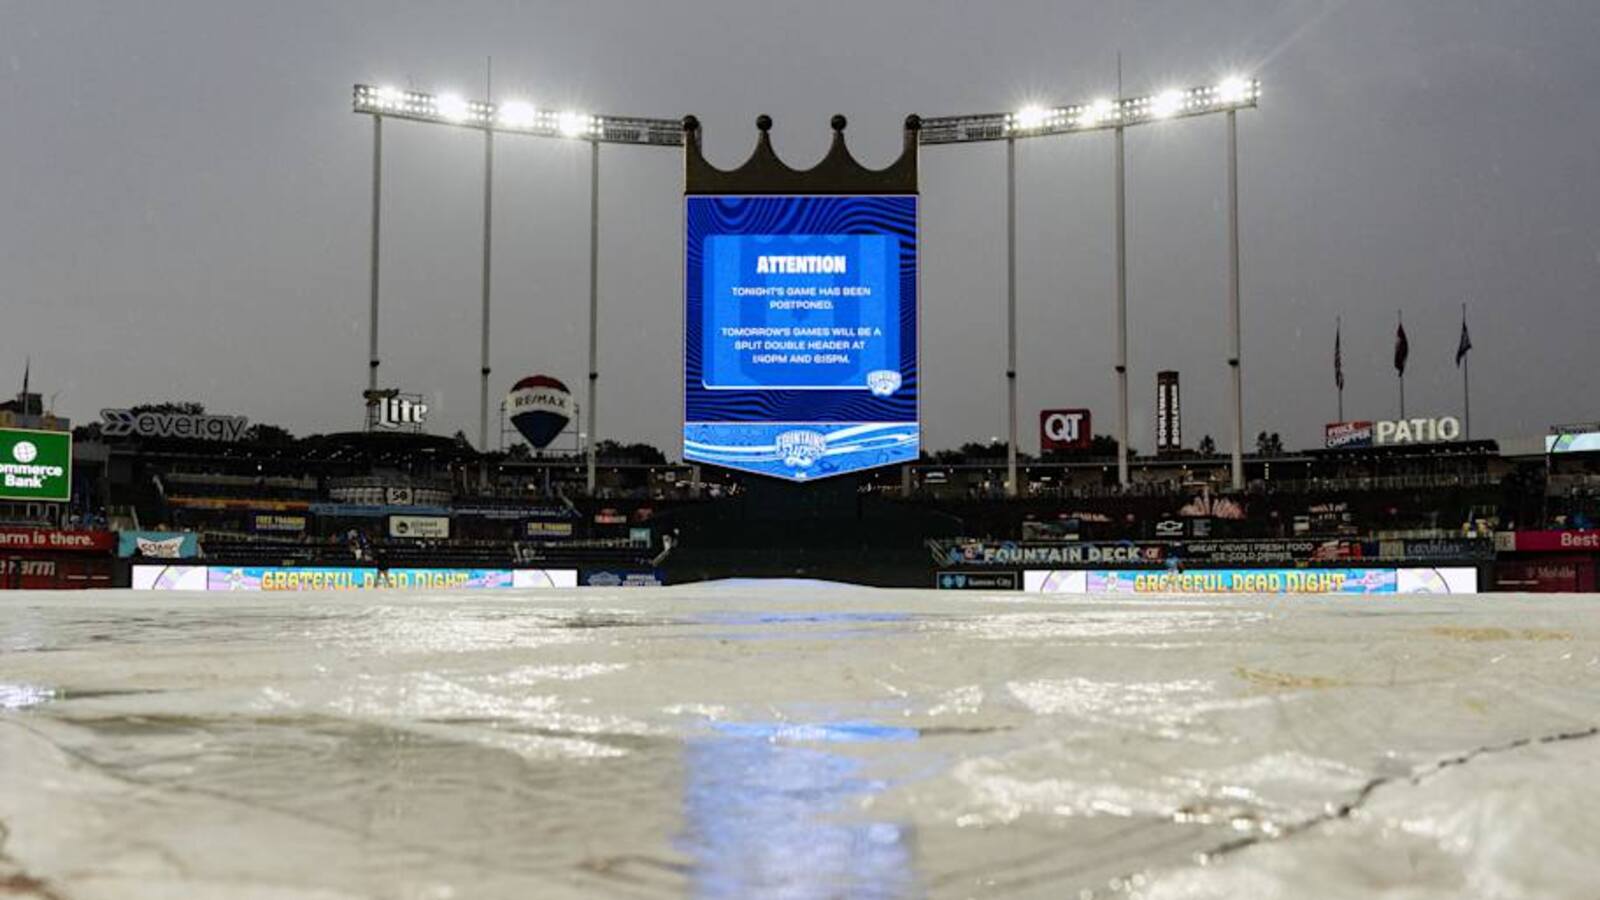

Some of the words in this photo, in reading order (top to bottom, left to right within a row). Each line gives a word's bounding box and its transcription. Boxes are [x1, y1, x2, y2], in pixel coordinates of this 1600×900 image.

[757, 256, 846, 273] ATTENTION
[732, 287, 784, 296] TONIGHT'S
[786, 287, 816, 296] GAME
[819, 287, 840, 296] HAS
[843, 287, 871, 296] BEEN
[769, 300, 834, 309] POSTPONED.
[722, 327, 790, 336] TOMORROW'S
[793, 327, 830, 336] GAMES
[832, 327, 855, 336] WILL
[858, 327, 871, 336] BE
[873, 327, 881, 336] A
[735, 341, 761, 350] SPLIT
[764, 341, 806, 350] DOUBLE
[808, 341, 850, 350] HEADER
[852, 341, 865, 350] AT
[789, 354, 812, 363] AND
[514, 393, 565, 408] RE/MAX
[377, 397, 428, 429] Lite
[137, 412, 247, 441] evergy
[1045, 413, 1083, 442] QT
[1377, 416, 1460, 442] PATIO
[5, 475, 42, 488] Bank
[33, 531, 46, 544] is
[50, 532, 95, 546] there.
[1561, 532, 1598, 546] Best
[984, 547, 1082, 562] FOUNTAIN
[1089, 547, 1140, 561] DECK
[1288, 543, 1314, 552] FOOD
[262, 571, 358, 589] GRATEFUL
[364, 572, 409, 589] DAD
[415, 572, 468, 589] NIGHT
[1135, 573, 1226, 592] GRATEFUL
[1232, 573, 1280, 592] DEAD
[1287, 573, 1346, 592] NIGHT
